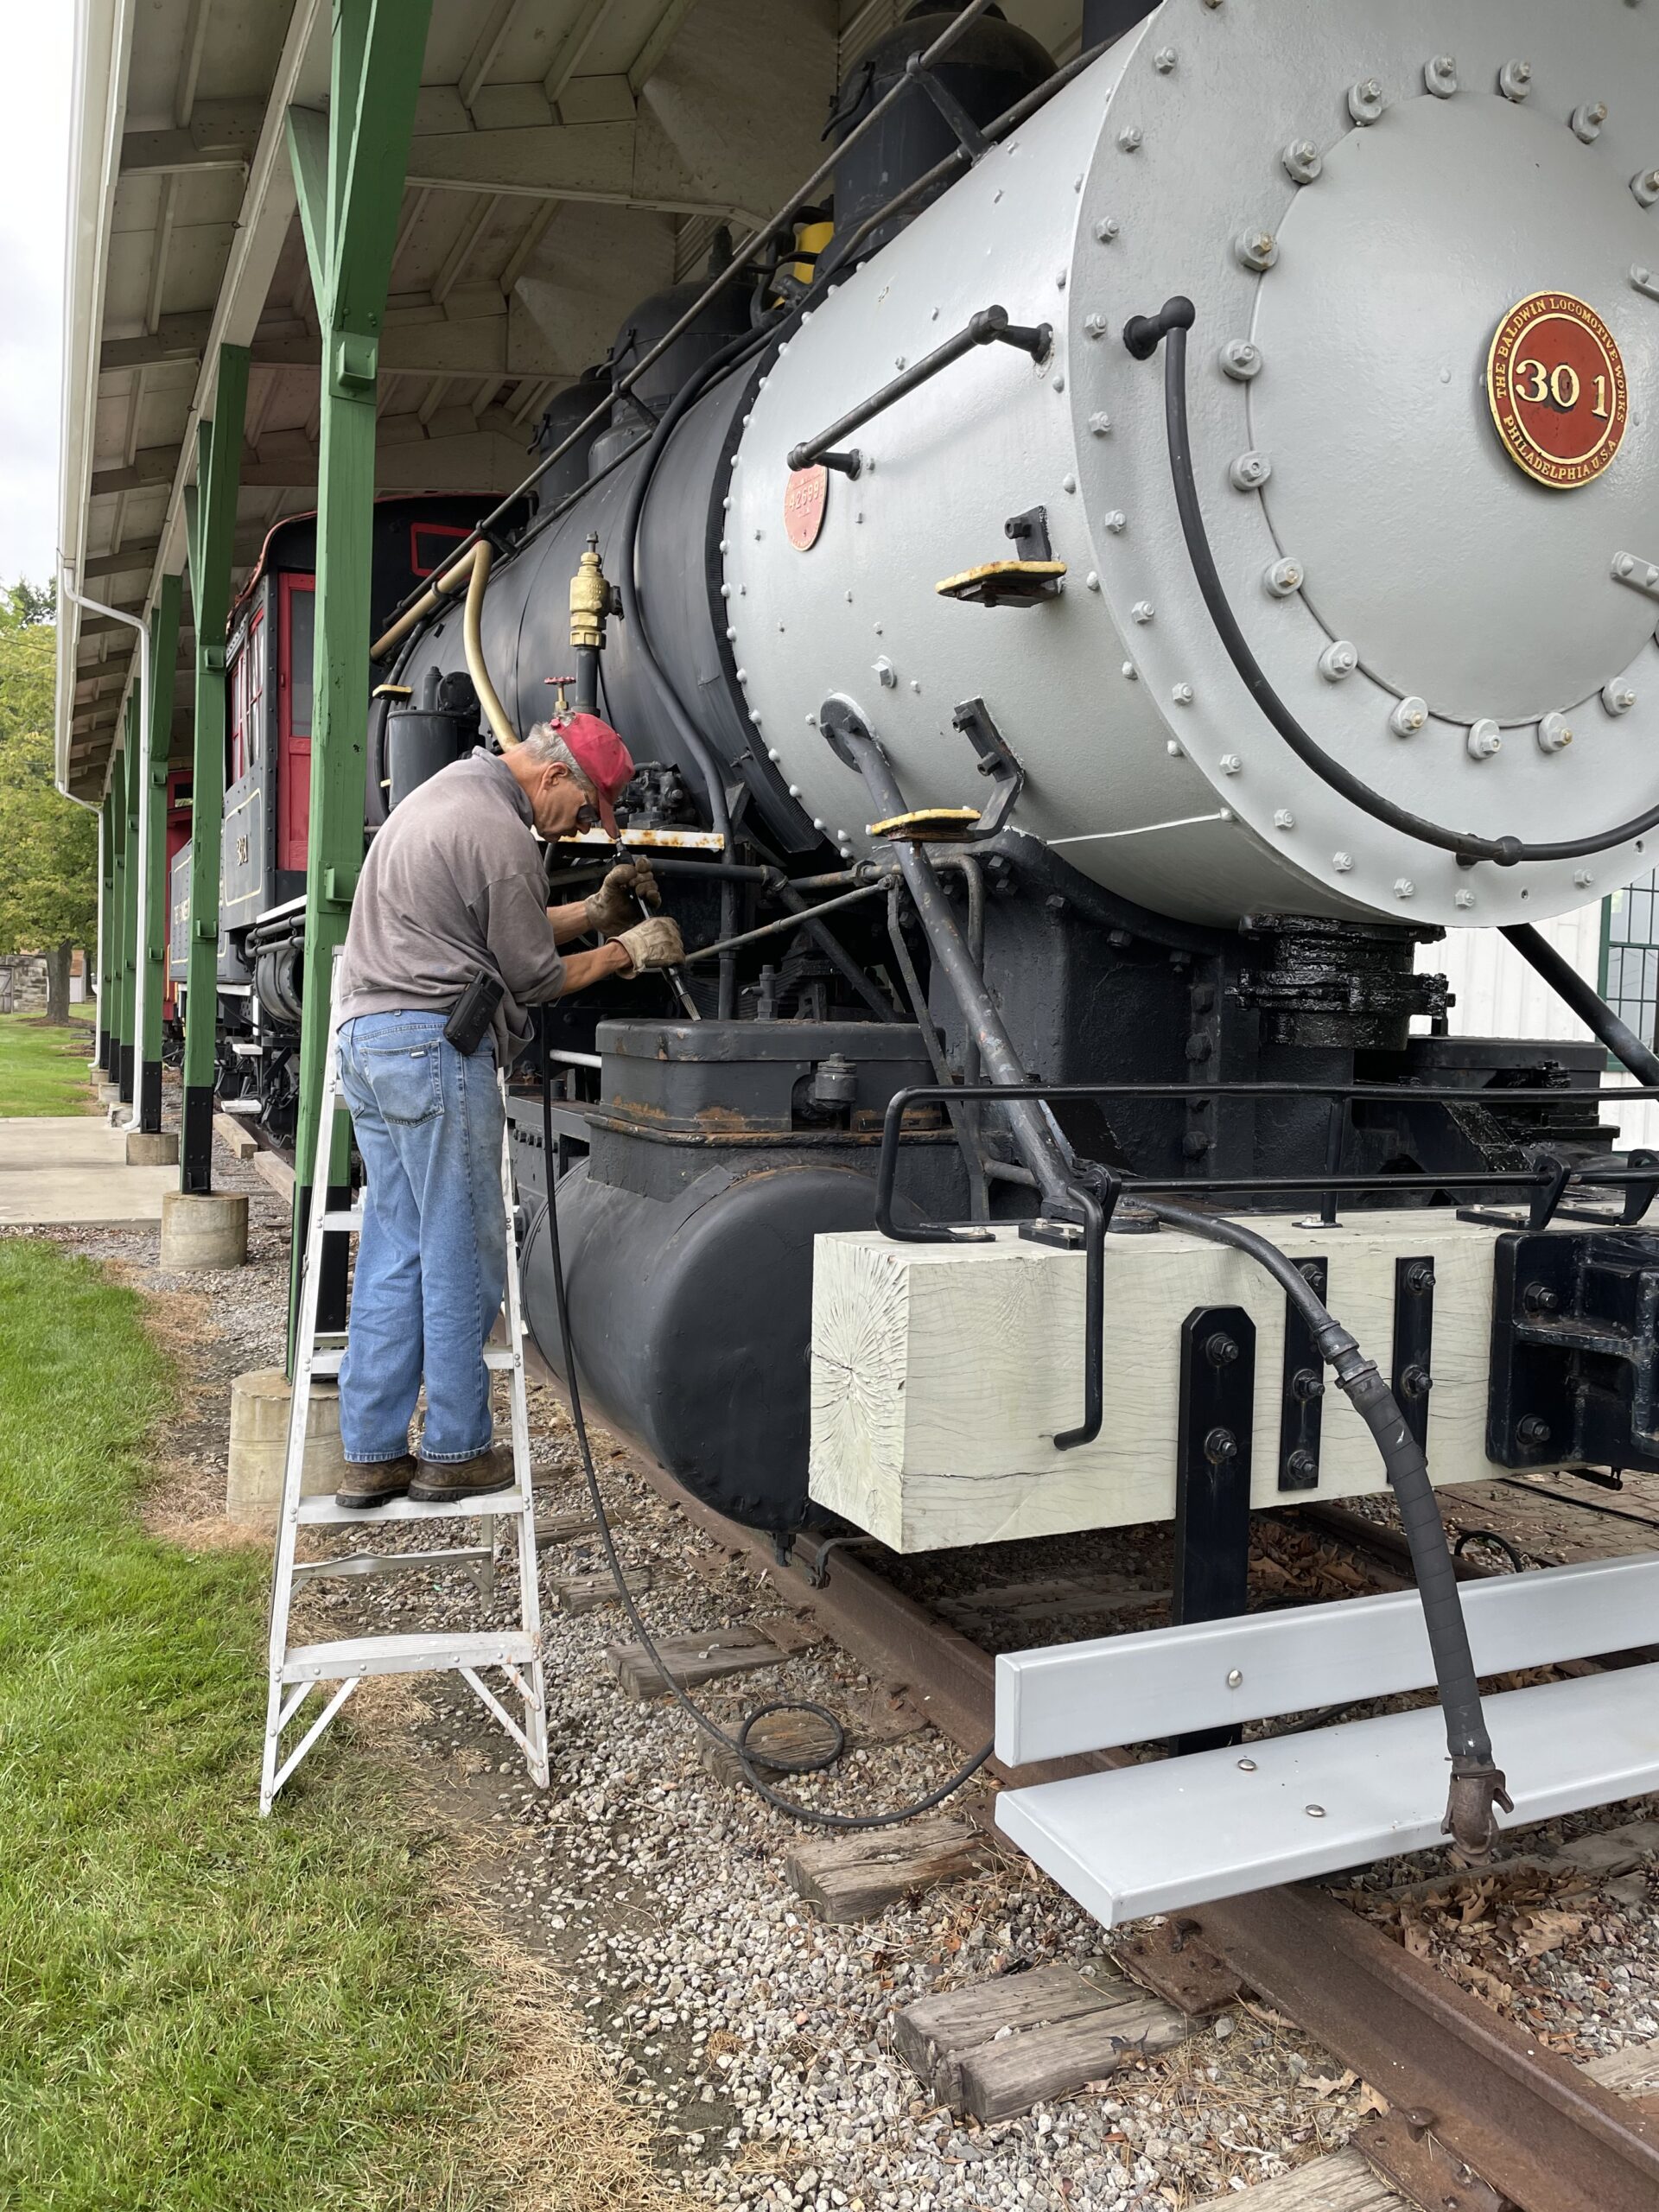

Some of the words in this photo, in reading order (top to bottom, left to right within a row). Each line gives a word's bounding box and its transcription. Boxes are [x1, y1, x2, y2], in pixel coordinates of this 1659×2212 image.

[1498, 299, 1546, 358] BALDWIN
[1549, 297, 1617, 361] LOCOMOTIVE
[1496, 363, 1506, 398] THE
[1615, 365, 1625, 423] WORKS
[789, 480, 819, 512] 42699
